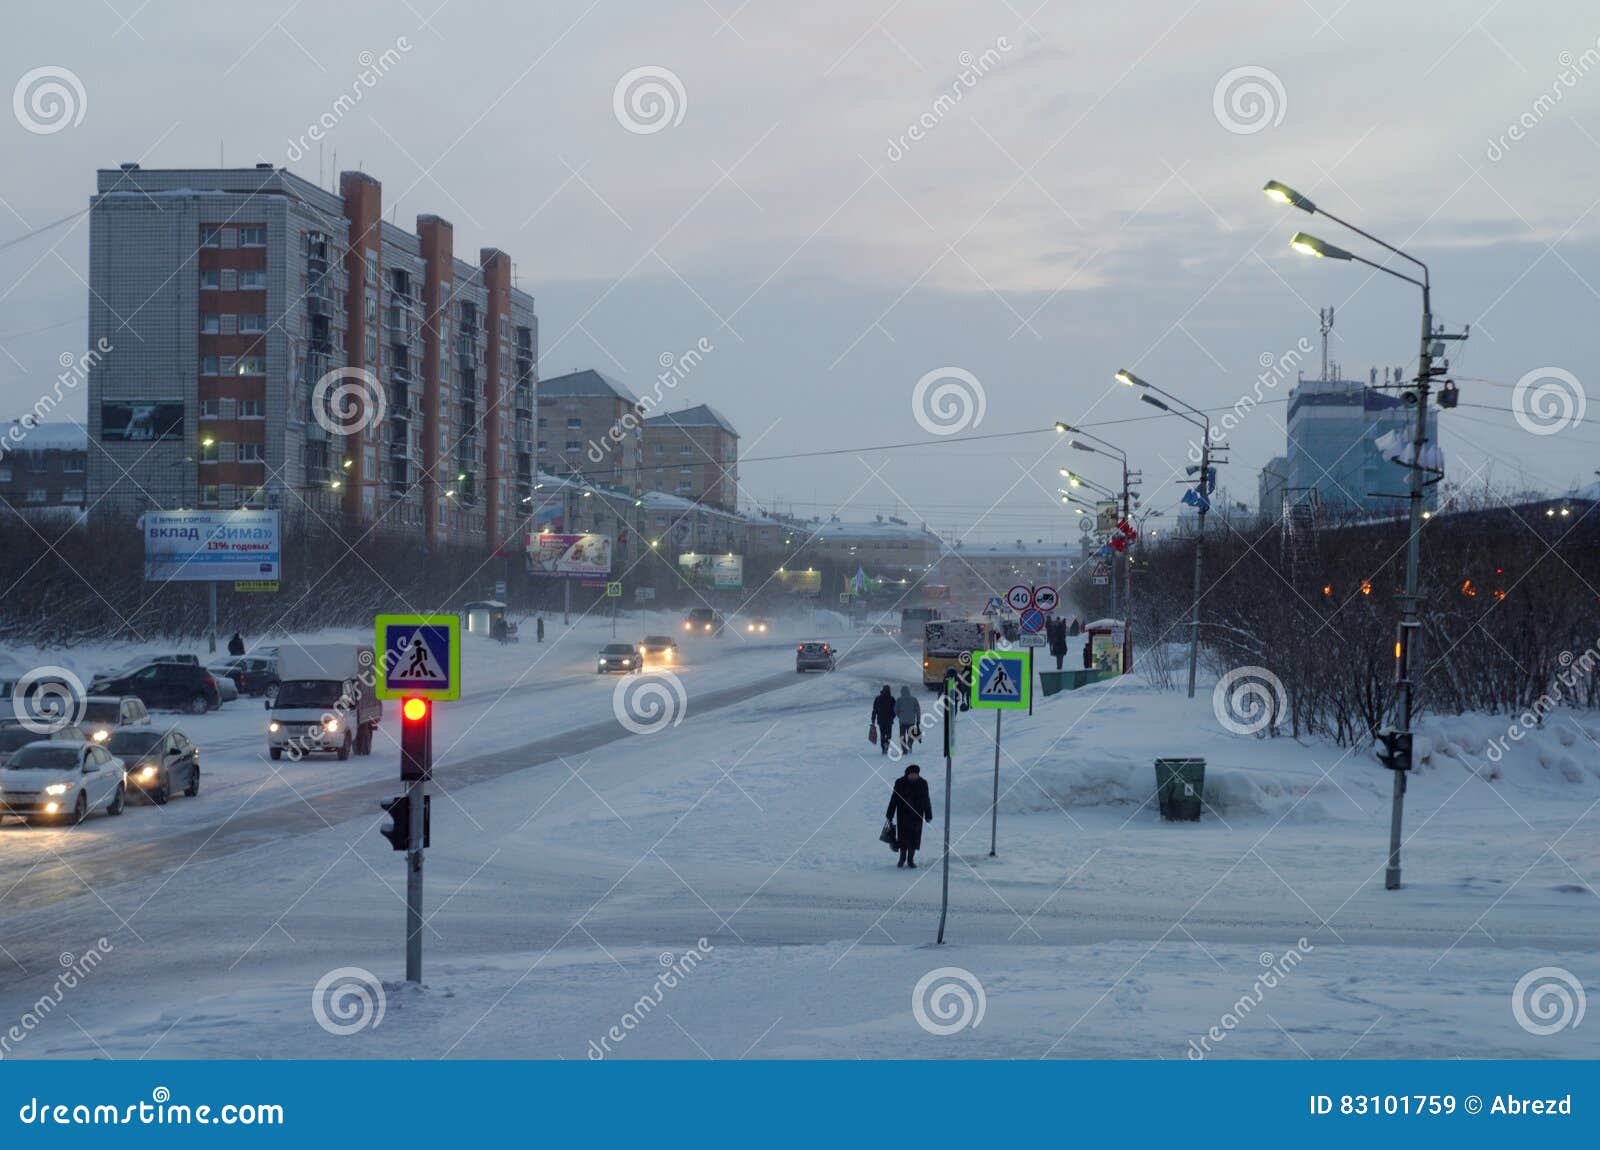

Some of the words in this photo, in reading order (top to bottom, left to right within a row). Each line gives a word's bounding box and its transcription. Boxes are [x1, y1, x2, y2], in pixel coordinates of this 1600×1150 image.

[150, 527, 200, 541] вклад
[208, 541, 229, 550] 13%
[1013, 592, 1028, 603] 40
